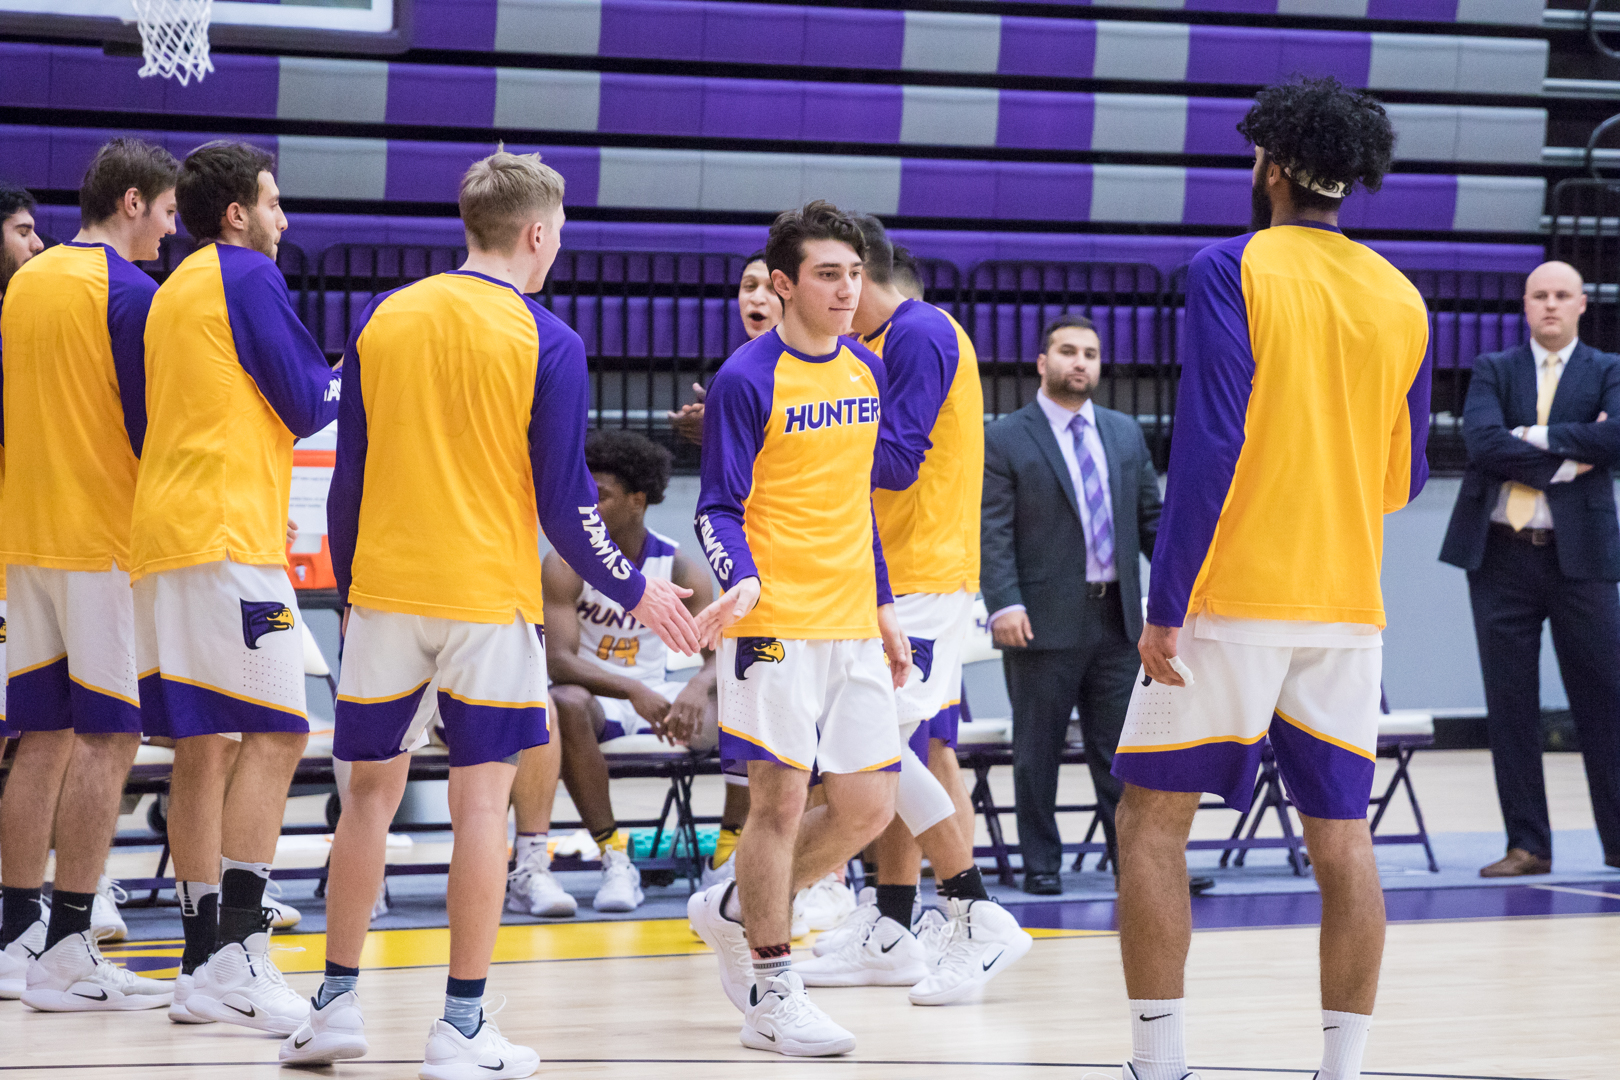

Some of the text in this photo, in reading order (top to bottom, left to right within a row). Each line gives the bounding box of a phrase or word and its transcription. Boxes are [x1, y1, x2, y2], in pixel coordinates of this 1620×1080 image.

[784, 396, 880, 434] HUNTER
[578, 504, 633, 580] HAWKS
[576, 601, 646, 630] HUNT
[596, 634, 640, 667] 14
